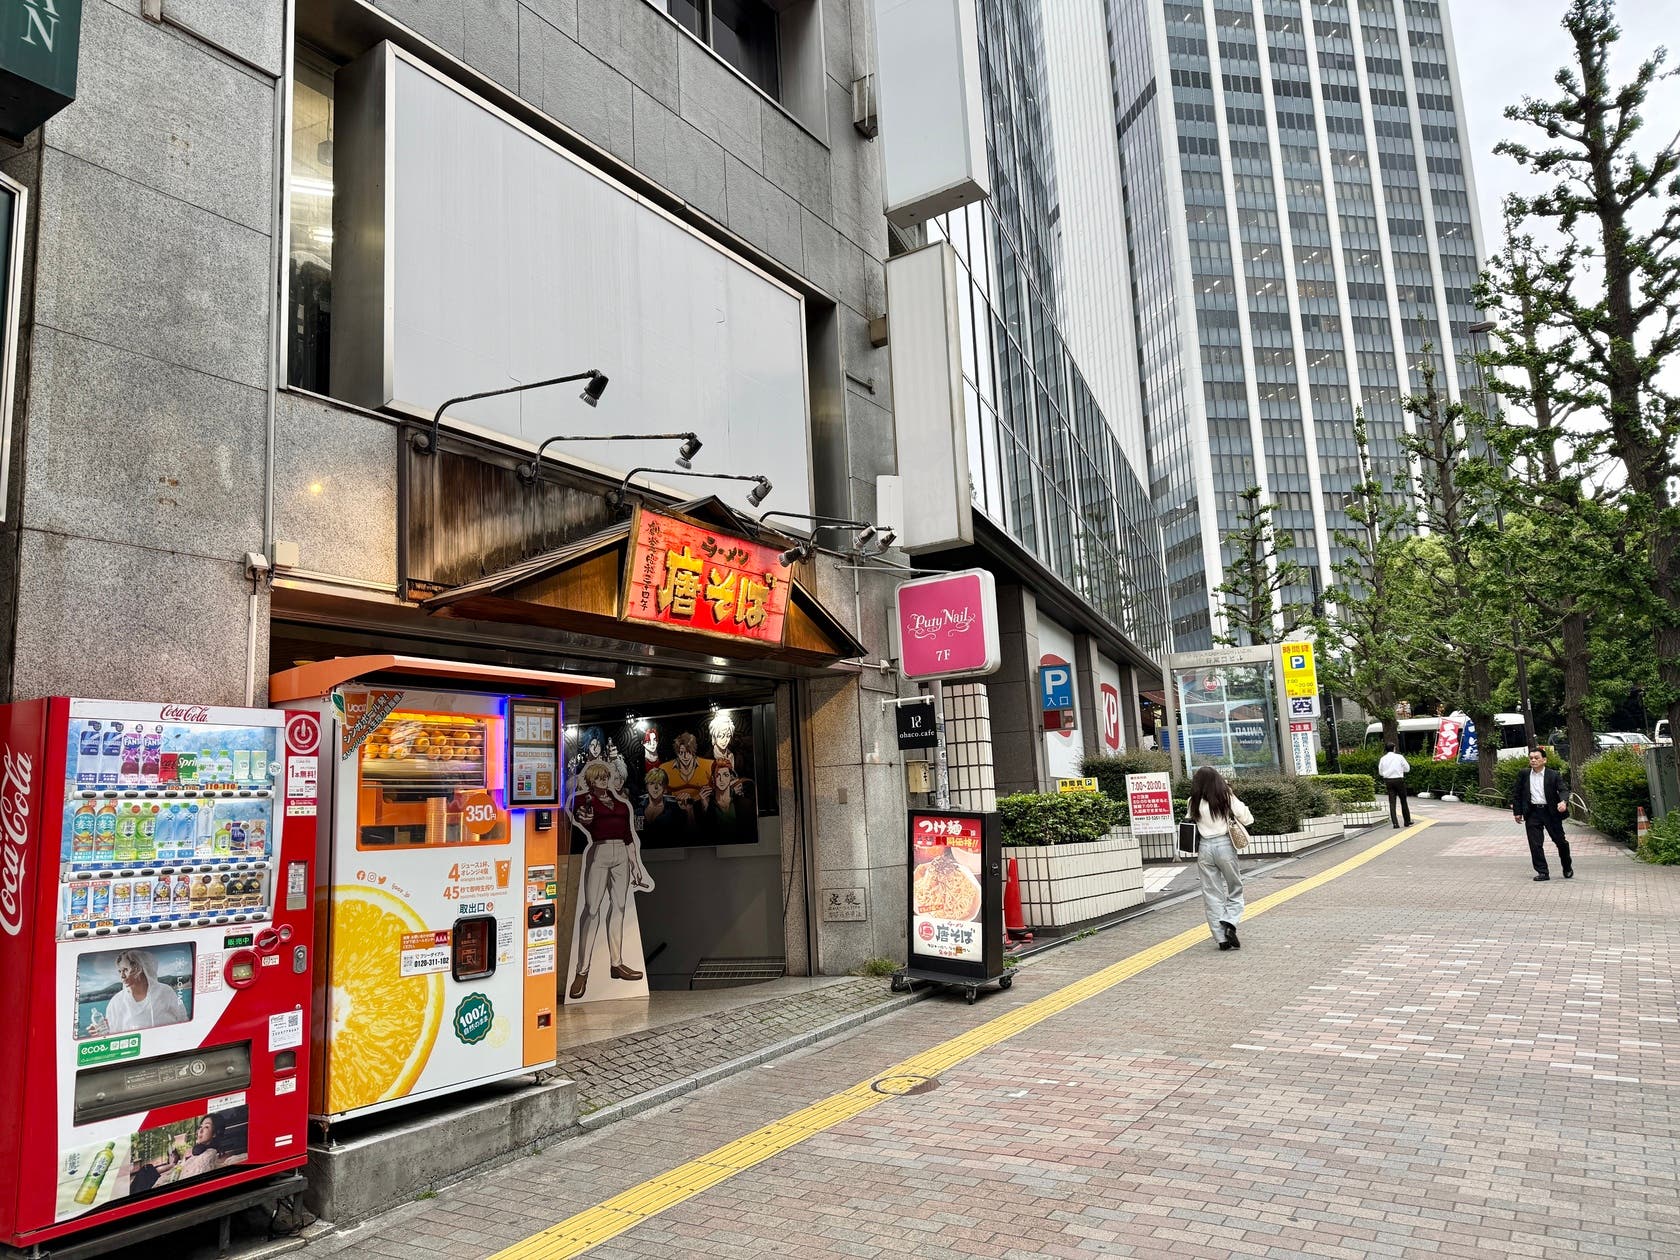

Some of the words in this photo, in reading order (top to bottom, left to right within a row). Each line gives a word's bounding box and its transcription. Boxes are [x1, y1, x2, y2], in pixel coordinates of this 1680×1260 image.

[701, 536, 749, 566] ラーメン
[657, 545, 778, 629] 唐そば
[943, 607, 974, 631] Nail
[935, 649, 951, 661] 7F
[1282, 645, 1309, 654] 時間貸
[1292, 657, 1304, 669] P
[1045, 669, 1068, 695] P
[1047, 696, 1069, 707] 入口
[160, 705, 208, 722] Coca-Cola
[900, 730, 935, 738] ohaco.cafe
[1235, 727, 1264, 737] DAIWA
[919, 820, 962, 835] つけ麺
[448, 863, 460, 882] 4
[443, 885, 460, 900] 45
[459, 902, 485, 914] 取出口
[936, 924, 976, 944] 唐そば
[460, 1003, 487, 1027] 100%
